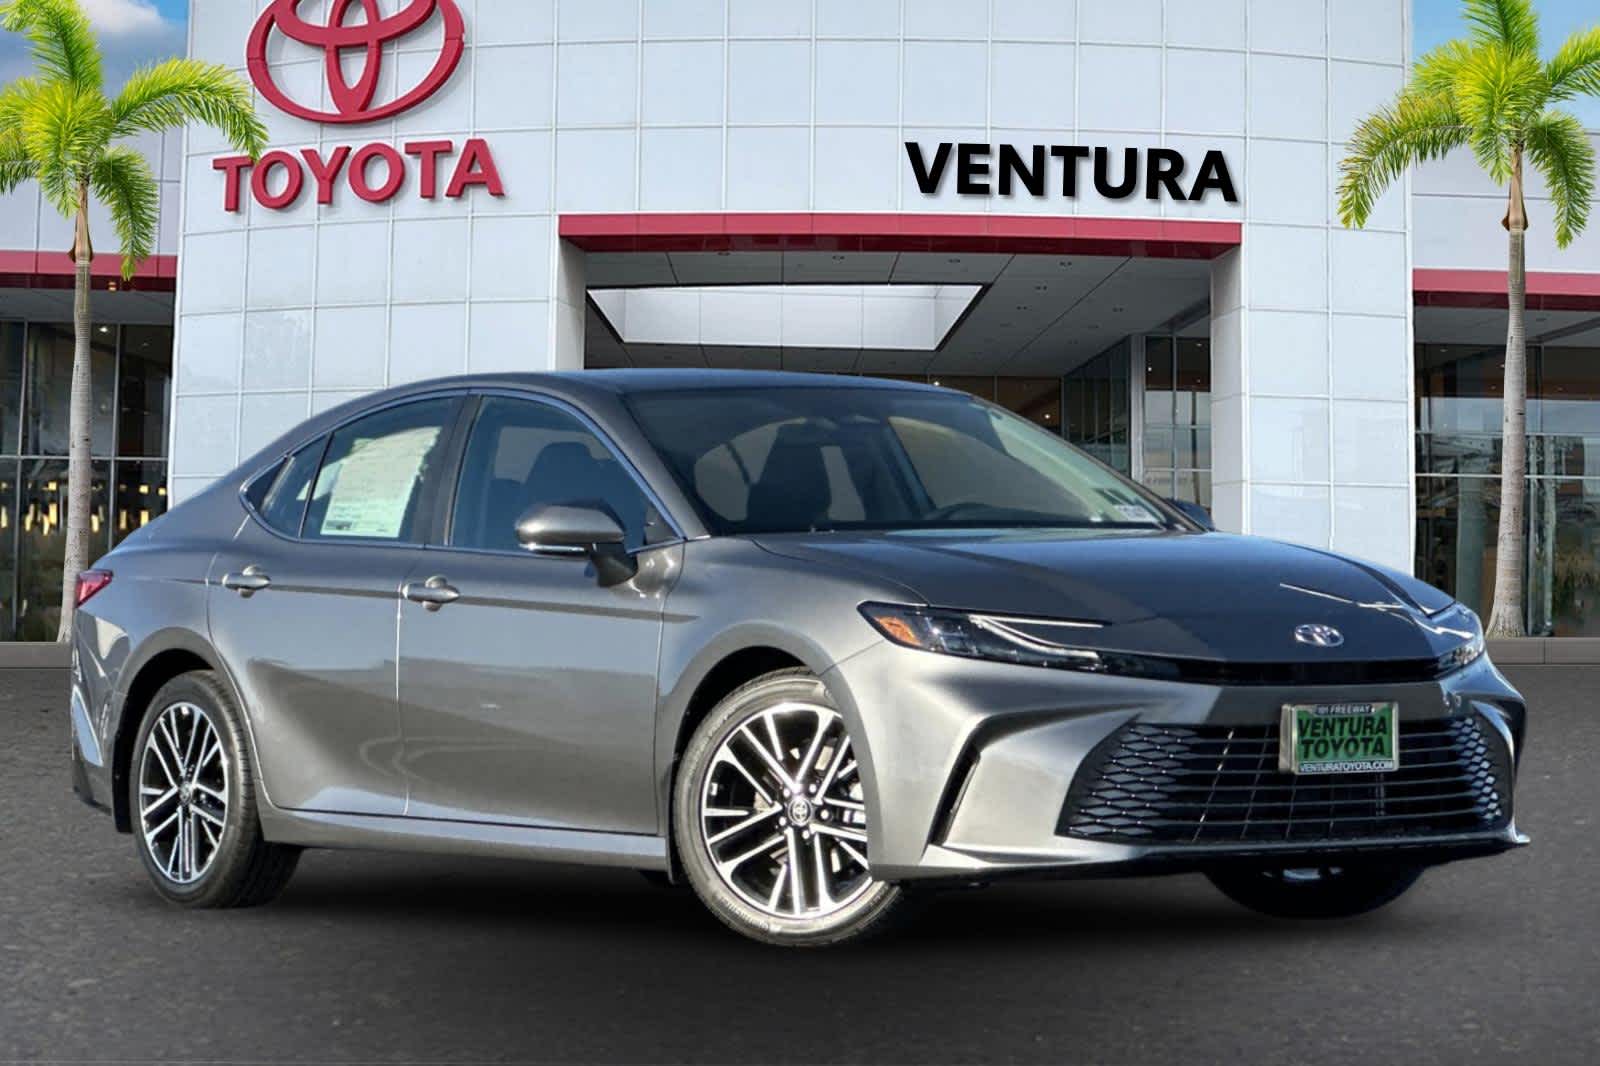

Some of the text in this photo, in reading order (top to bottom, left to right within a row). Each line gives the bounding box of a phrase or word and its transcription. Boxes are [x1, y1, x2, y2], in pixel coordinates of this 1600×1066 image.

[213, 139, 504, 212] TOYOTA
[904, 142, 1239, 203] VENTURA
[1330, 704, 1371, 714] FREEWAY
[1298, 716, 1387, 737] VENTURA
[1301, 736, 1385, 759] TOYOTA
[1300, 761, 1393, 772] VENTURATOYOTA.COM
